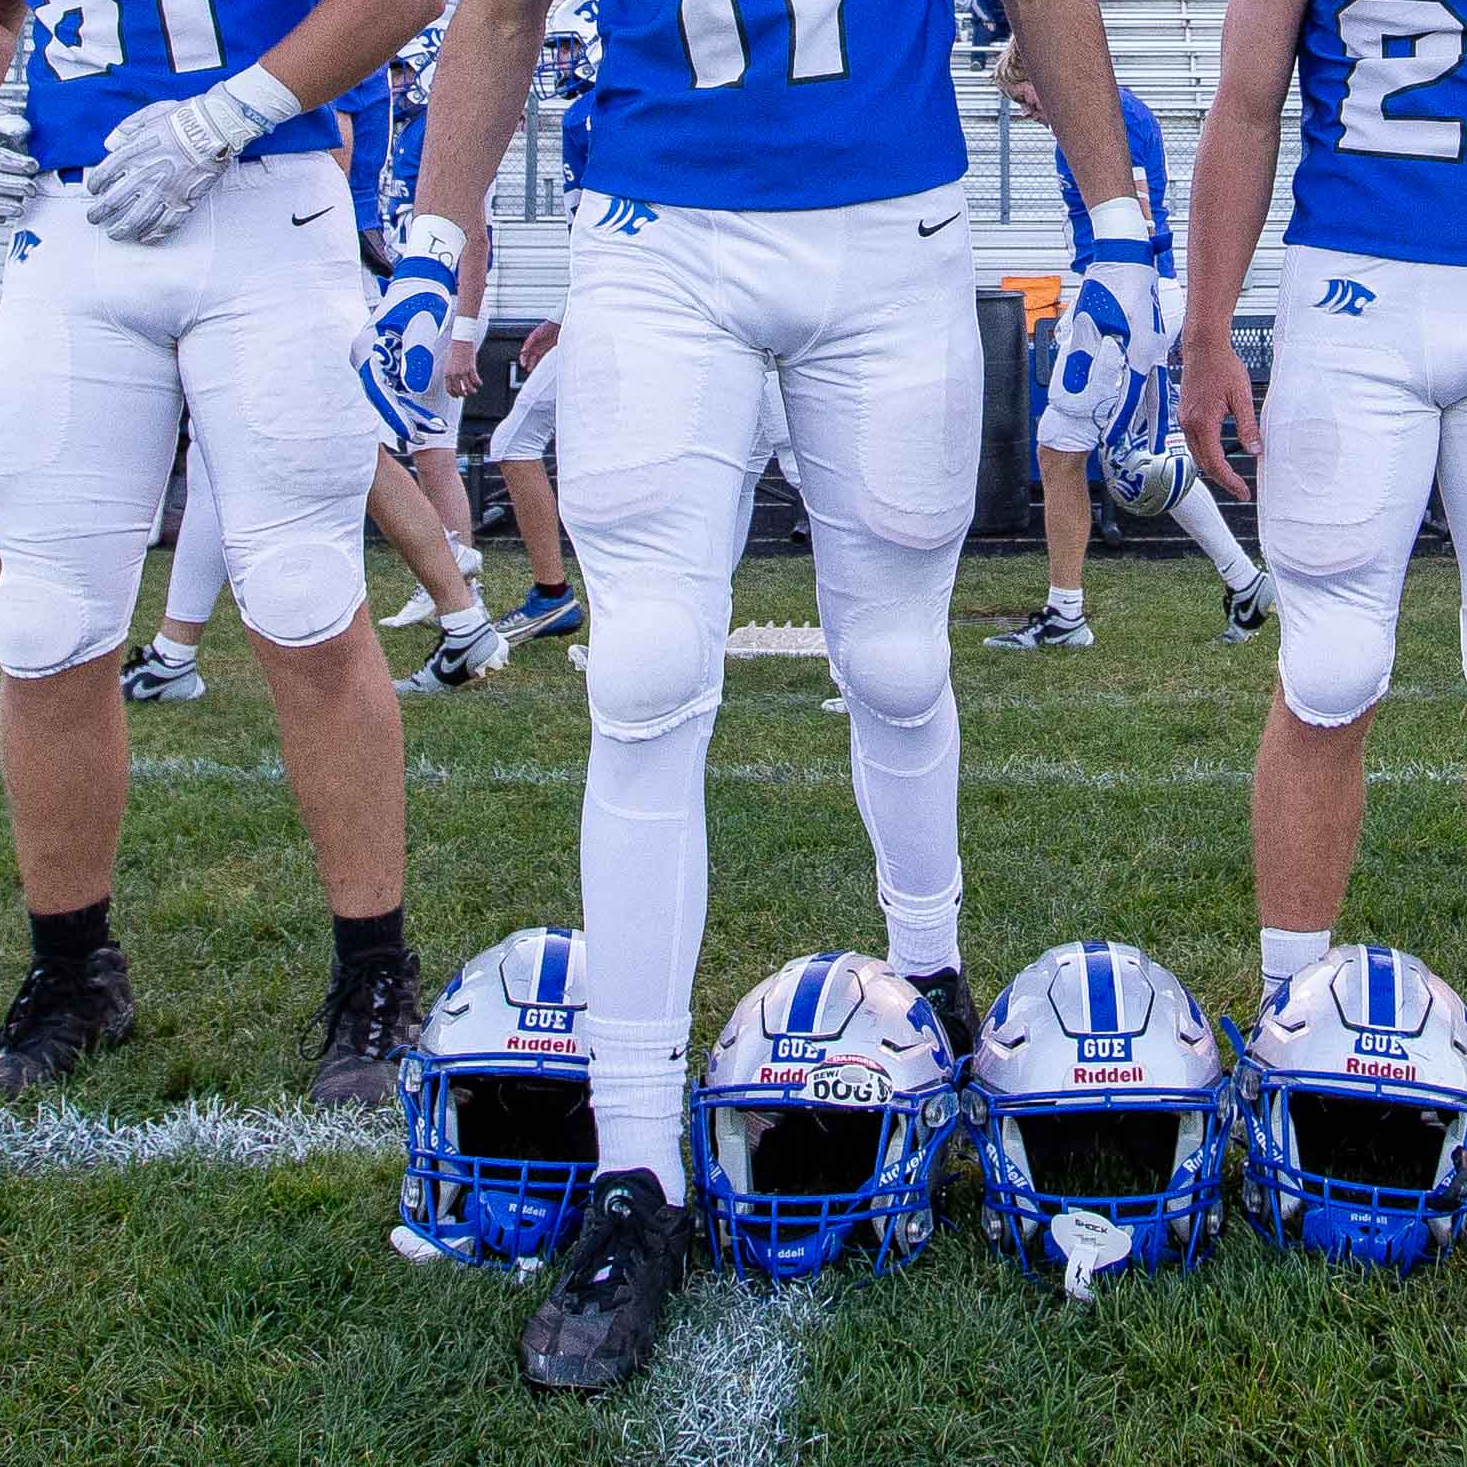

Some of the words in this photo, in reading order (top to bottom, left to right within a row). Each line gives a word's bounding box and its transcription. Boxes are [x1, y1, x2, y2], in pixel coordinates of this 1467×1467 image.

[525, 1009, 568, 1031] GUE
[507, 1036, 577, 1054] Riddell
[778, 1037, 819, 1060] GUE
[1083, 1038, 1125, 1058] GUE
[1361, 1033, 1402, 1055] GUE
[760, 1067, 807, 1084] Ridd
[1074, 1067, 1143, 1084] Riddell
[1346, 1057, 1416, 1081] Riddell
[813, 1079, 873, 1103] DOG
